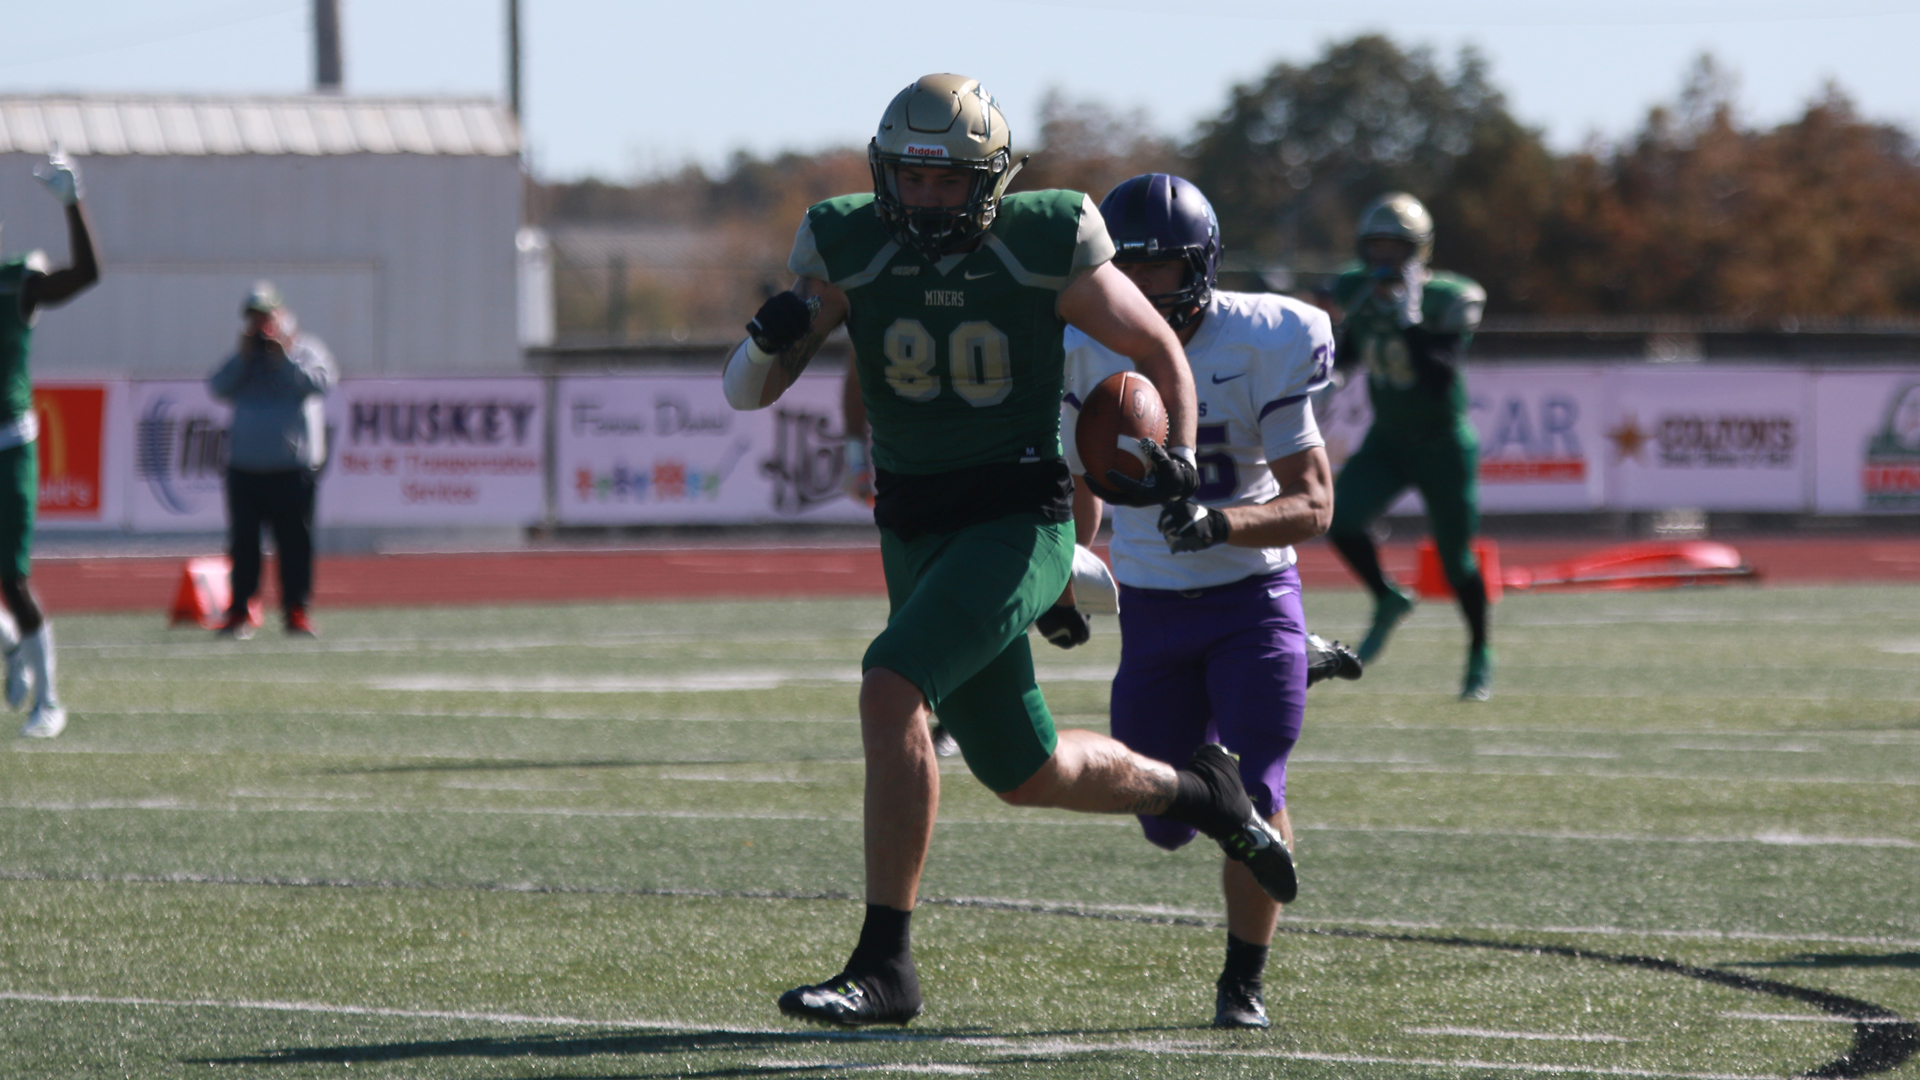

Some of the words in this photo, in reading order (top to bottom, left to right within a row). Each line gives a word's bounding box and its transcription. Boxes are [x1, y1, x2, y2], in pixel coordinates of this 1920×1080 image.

[907, 146, 944, 157] Riddell
[925, 290, 965, 307] MINERS
[883, 318, 1014, 408] 80
[350, 402, 536, 445] HUSKEY
